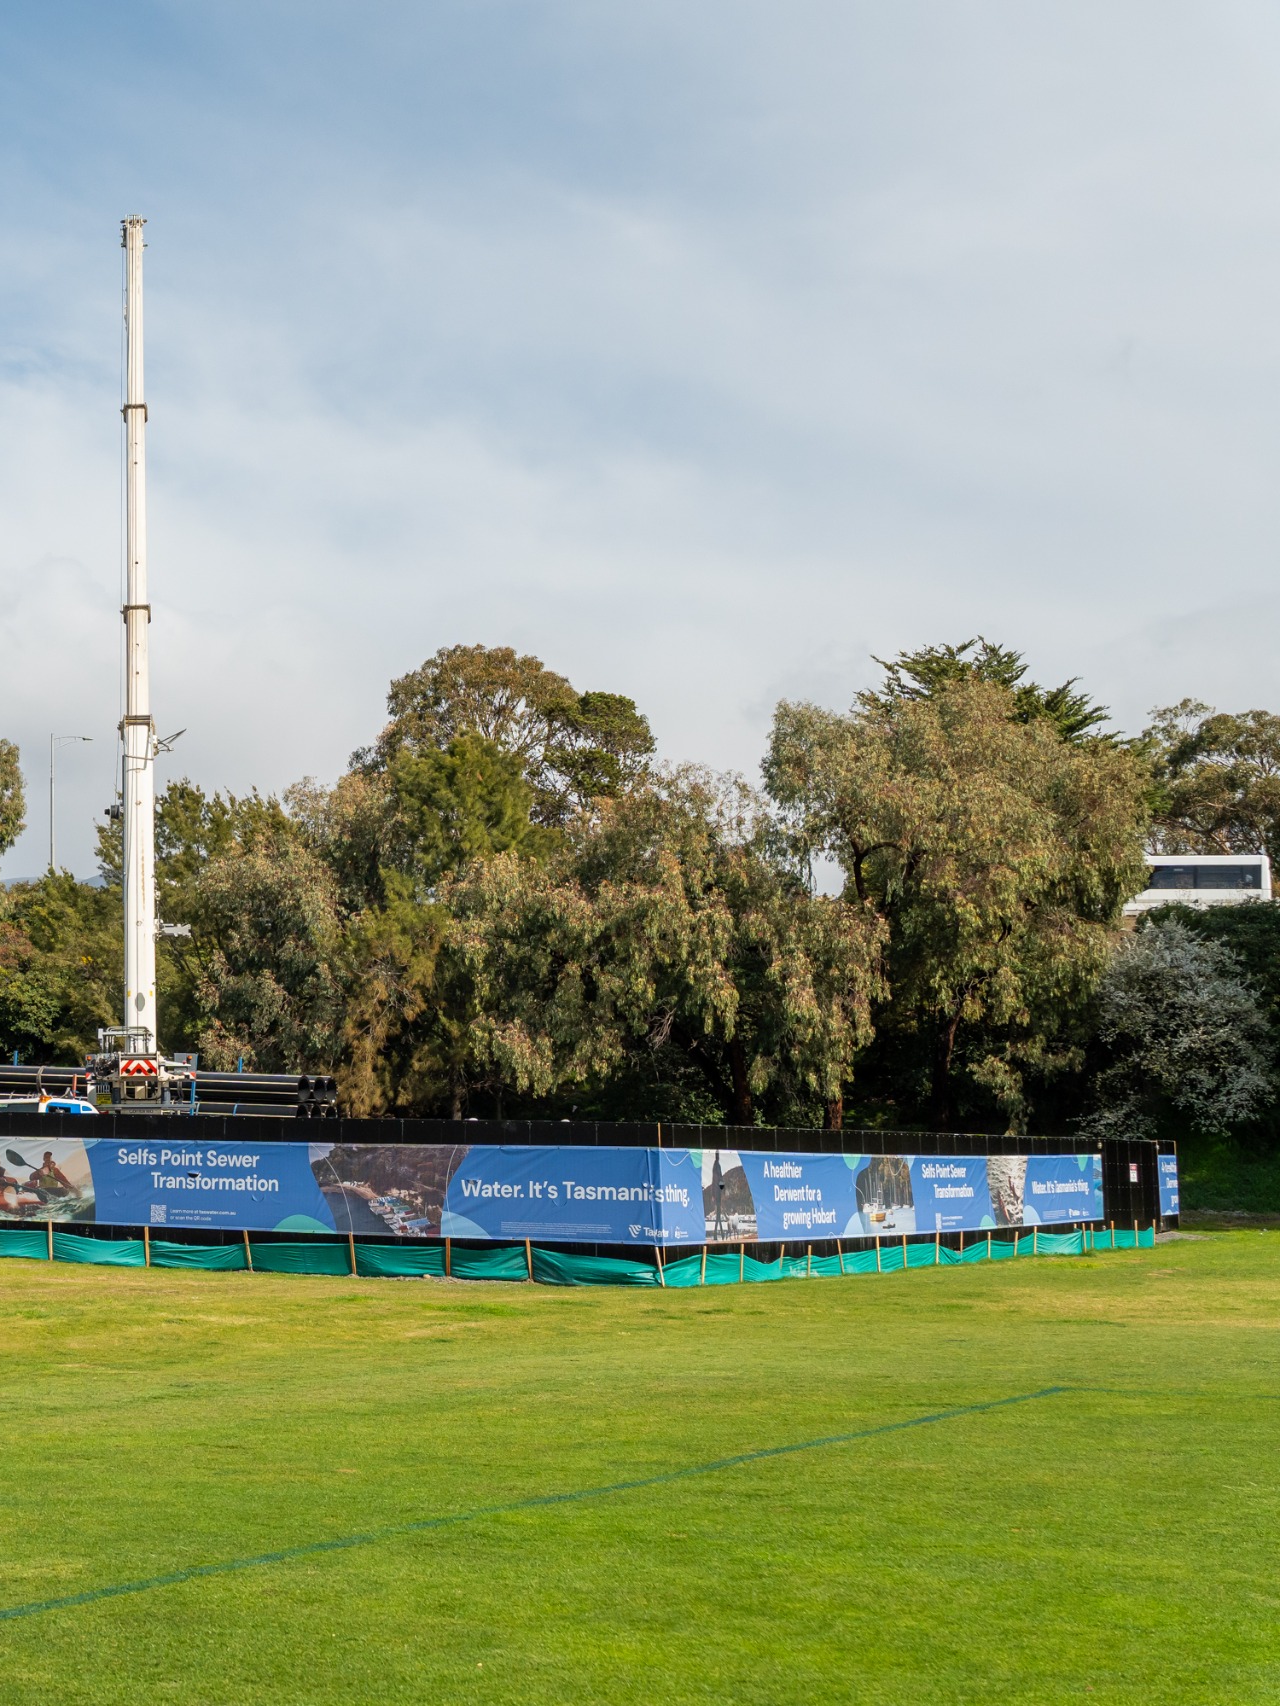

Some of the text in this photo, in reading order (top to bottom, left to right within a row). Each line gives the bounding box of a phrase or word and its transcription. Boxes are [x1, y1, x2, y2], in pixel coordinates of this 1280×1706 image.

[118, 1148, 260, 1168] Selfs Point Sewer
[763, 1161, 802, 1179] A healthier
[935, 1163, 950, 1178] Point
[151, 1171, 279, 1192] Transformation
[461, 1179, 524, 1199] Water.
[529, 1180, 558, 1199] It's
[665, 1183, 690, 1208] thing.
[774, 1183, 822, 1202] Derwent for a
[783, 1207, 836, 1230] growing Hobart
